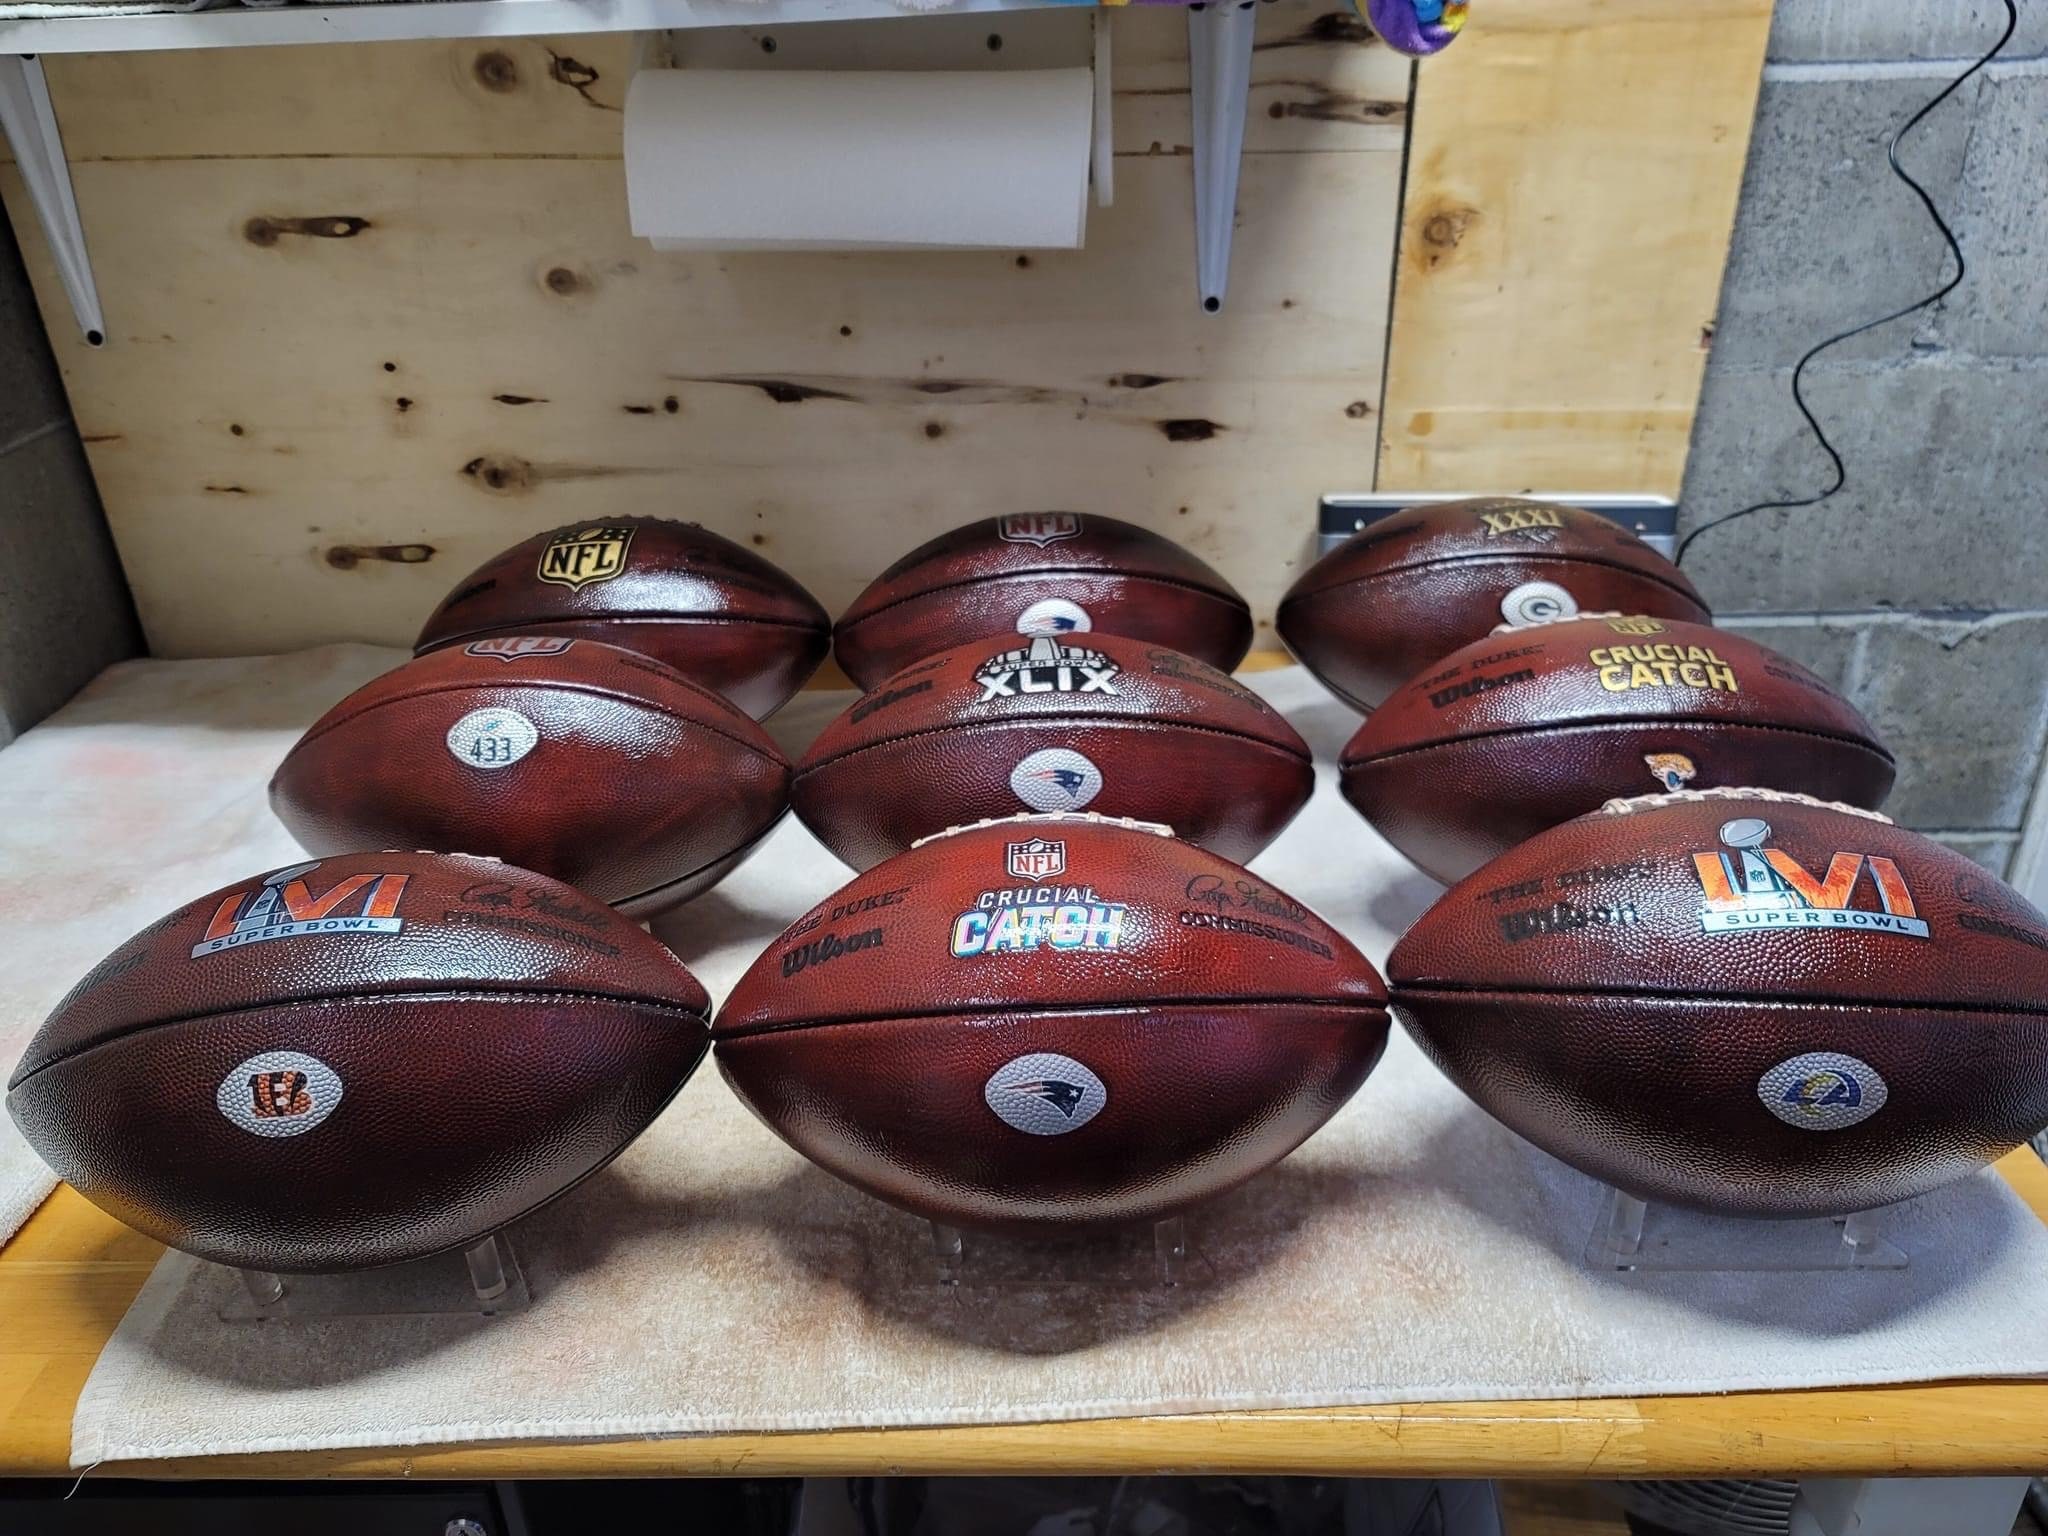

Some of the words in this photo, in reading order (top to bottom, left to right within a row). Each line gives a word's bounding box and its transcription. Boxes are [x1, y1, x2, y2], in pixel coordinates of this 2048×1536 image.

[1010, 513, 1074, 535] NFL
[1479, 509, 1564, 536] XXXI
[547, 543, 614, 577] NFL
[1589, 643, 1728, 668] CRUCIAL
[976, 665, 1119, 704] XLIX
[1600, 661, 1738, 694] CATCH
[470, 737, 512, 762] 433
[1015, 853, 1059, 875] NFL
[979, 887, 1100, 909] CRUCIAL
[1692, 848, 1918, 920] LVI
[210, 924, 295, 951] SUPER
[305, 918, 381, 932] BOWL
[952, 905, 1126, 957] CATCH
[1725, 911, 1821, 926] SUPER
[1833, 913, 1911, 931] BOWL
[782, 927, 884, 977] Wilson
